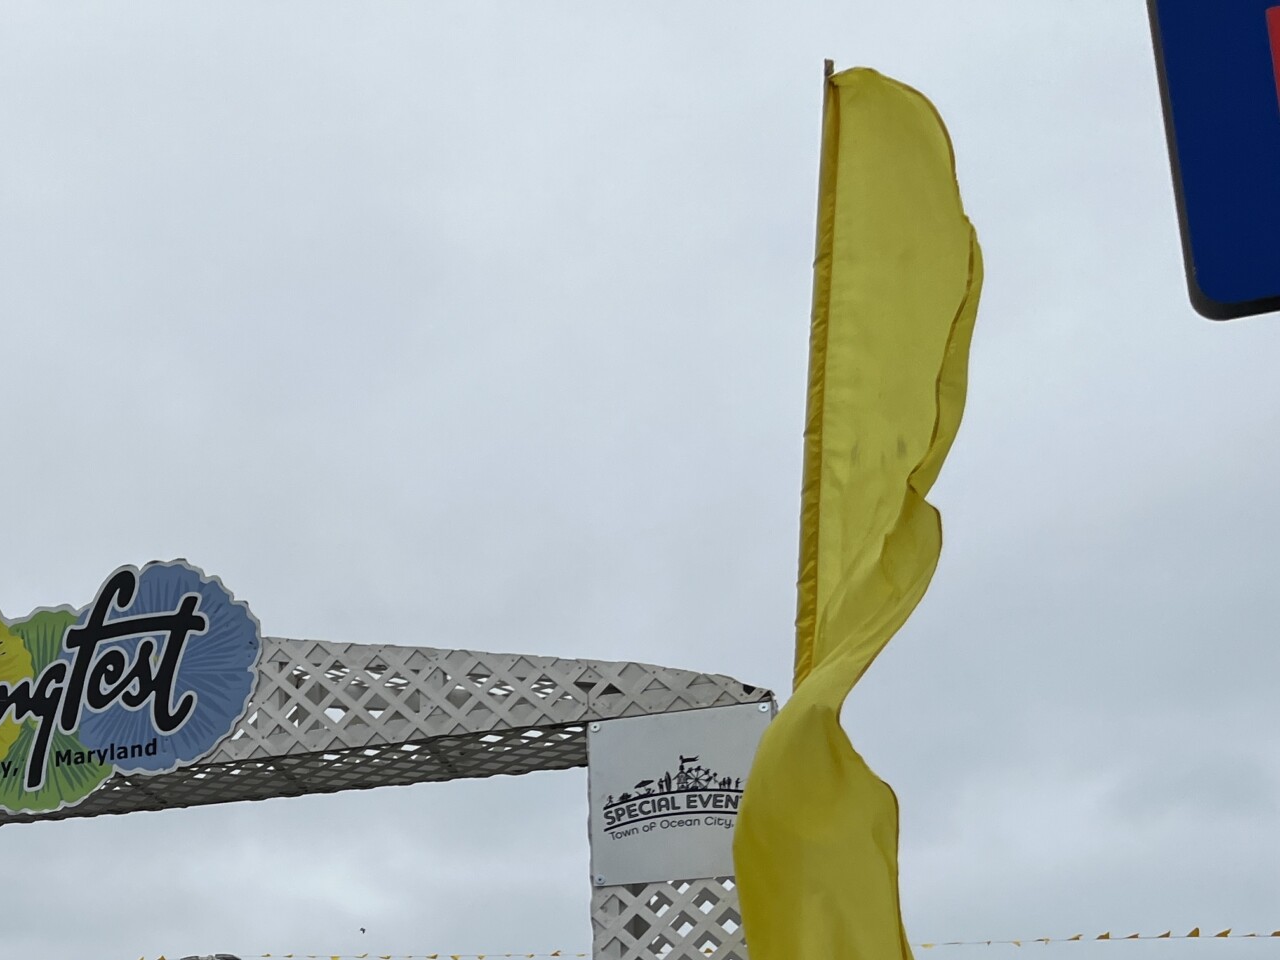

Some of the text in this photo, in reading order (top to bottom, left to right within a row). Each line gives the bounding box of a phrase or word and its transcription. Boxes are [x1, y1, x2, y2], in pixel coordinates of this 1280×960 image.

[55, 738, 157, 767] Maryland
[604, 794, 742, 826] SPECIAL EVEN
[609, 827, 639, 840] Town
[642, 821, 656, 833] of
[660, 818, 700, 829] Ocean
